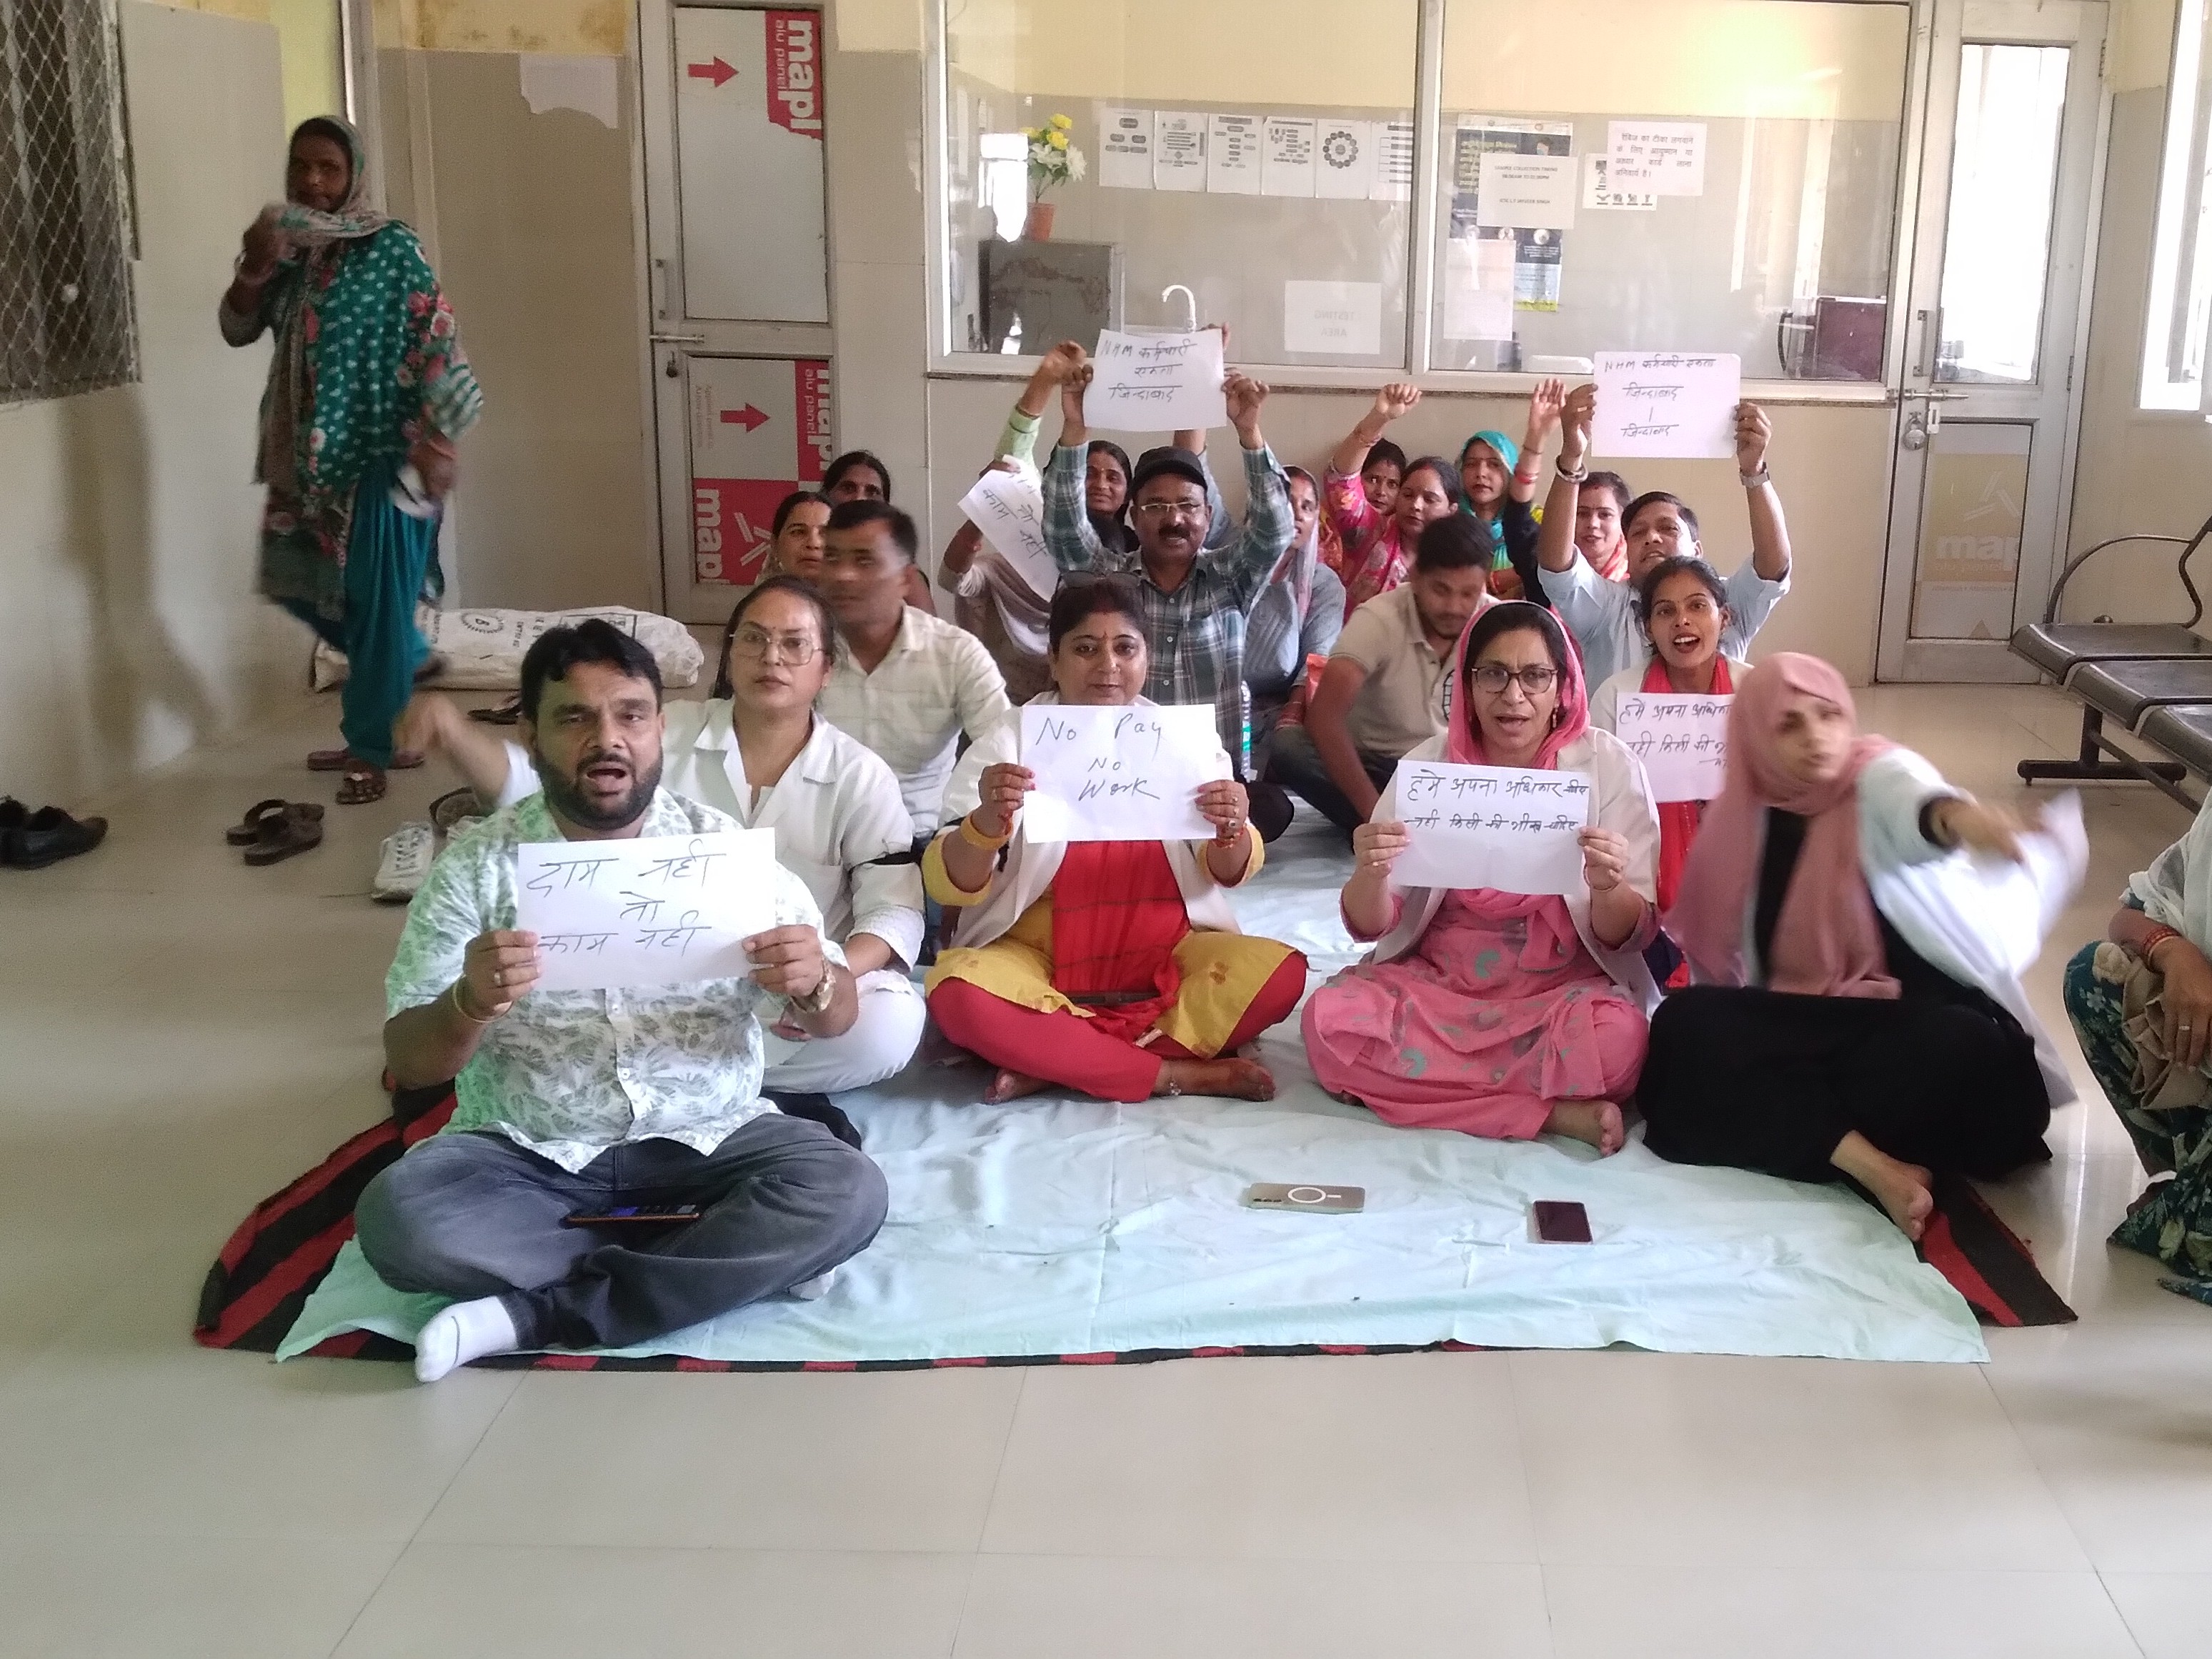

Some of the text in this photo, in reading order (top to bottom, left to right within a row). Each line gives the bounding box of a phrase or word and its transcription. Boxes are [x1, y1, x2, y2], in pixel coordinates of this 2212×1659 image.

[774, 19, 787, 90] alu panel
[804, 368, 817, 434] alu panel
[1035, 712, 1162, 762] No Pay
[1087, 757, 1121, 772] No
[1078, 777, 1160, 802] Work
[1450, 778, 1498, 799] अपना
[1505, 775, 1563, 799] अधिकार
[526, 857, 620, 898] दाम
[619, 890, 666, 923] तो
